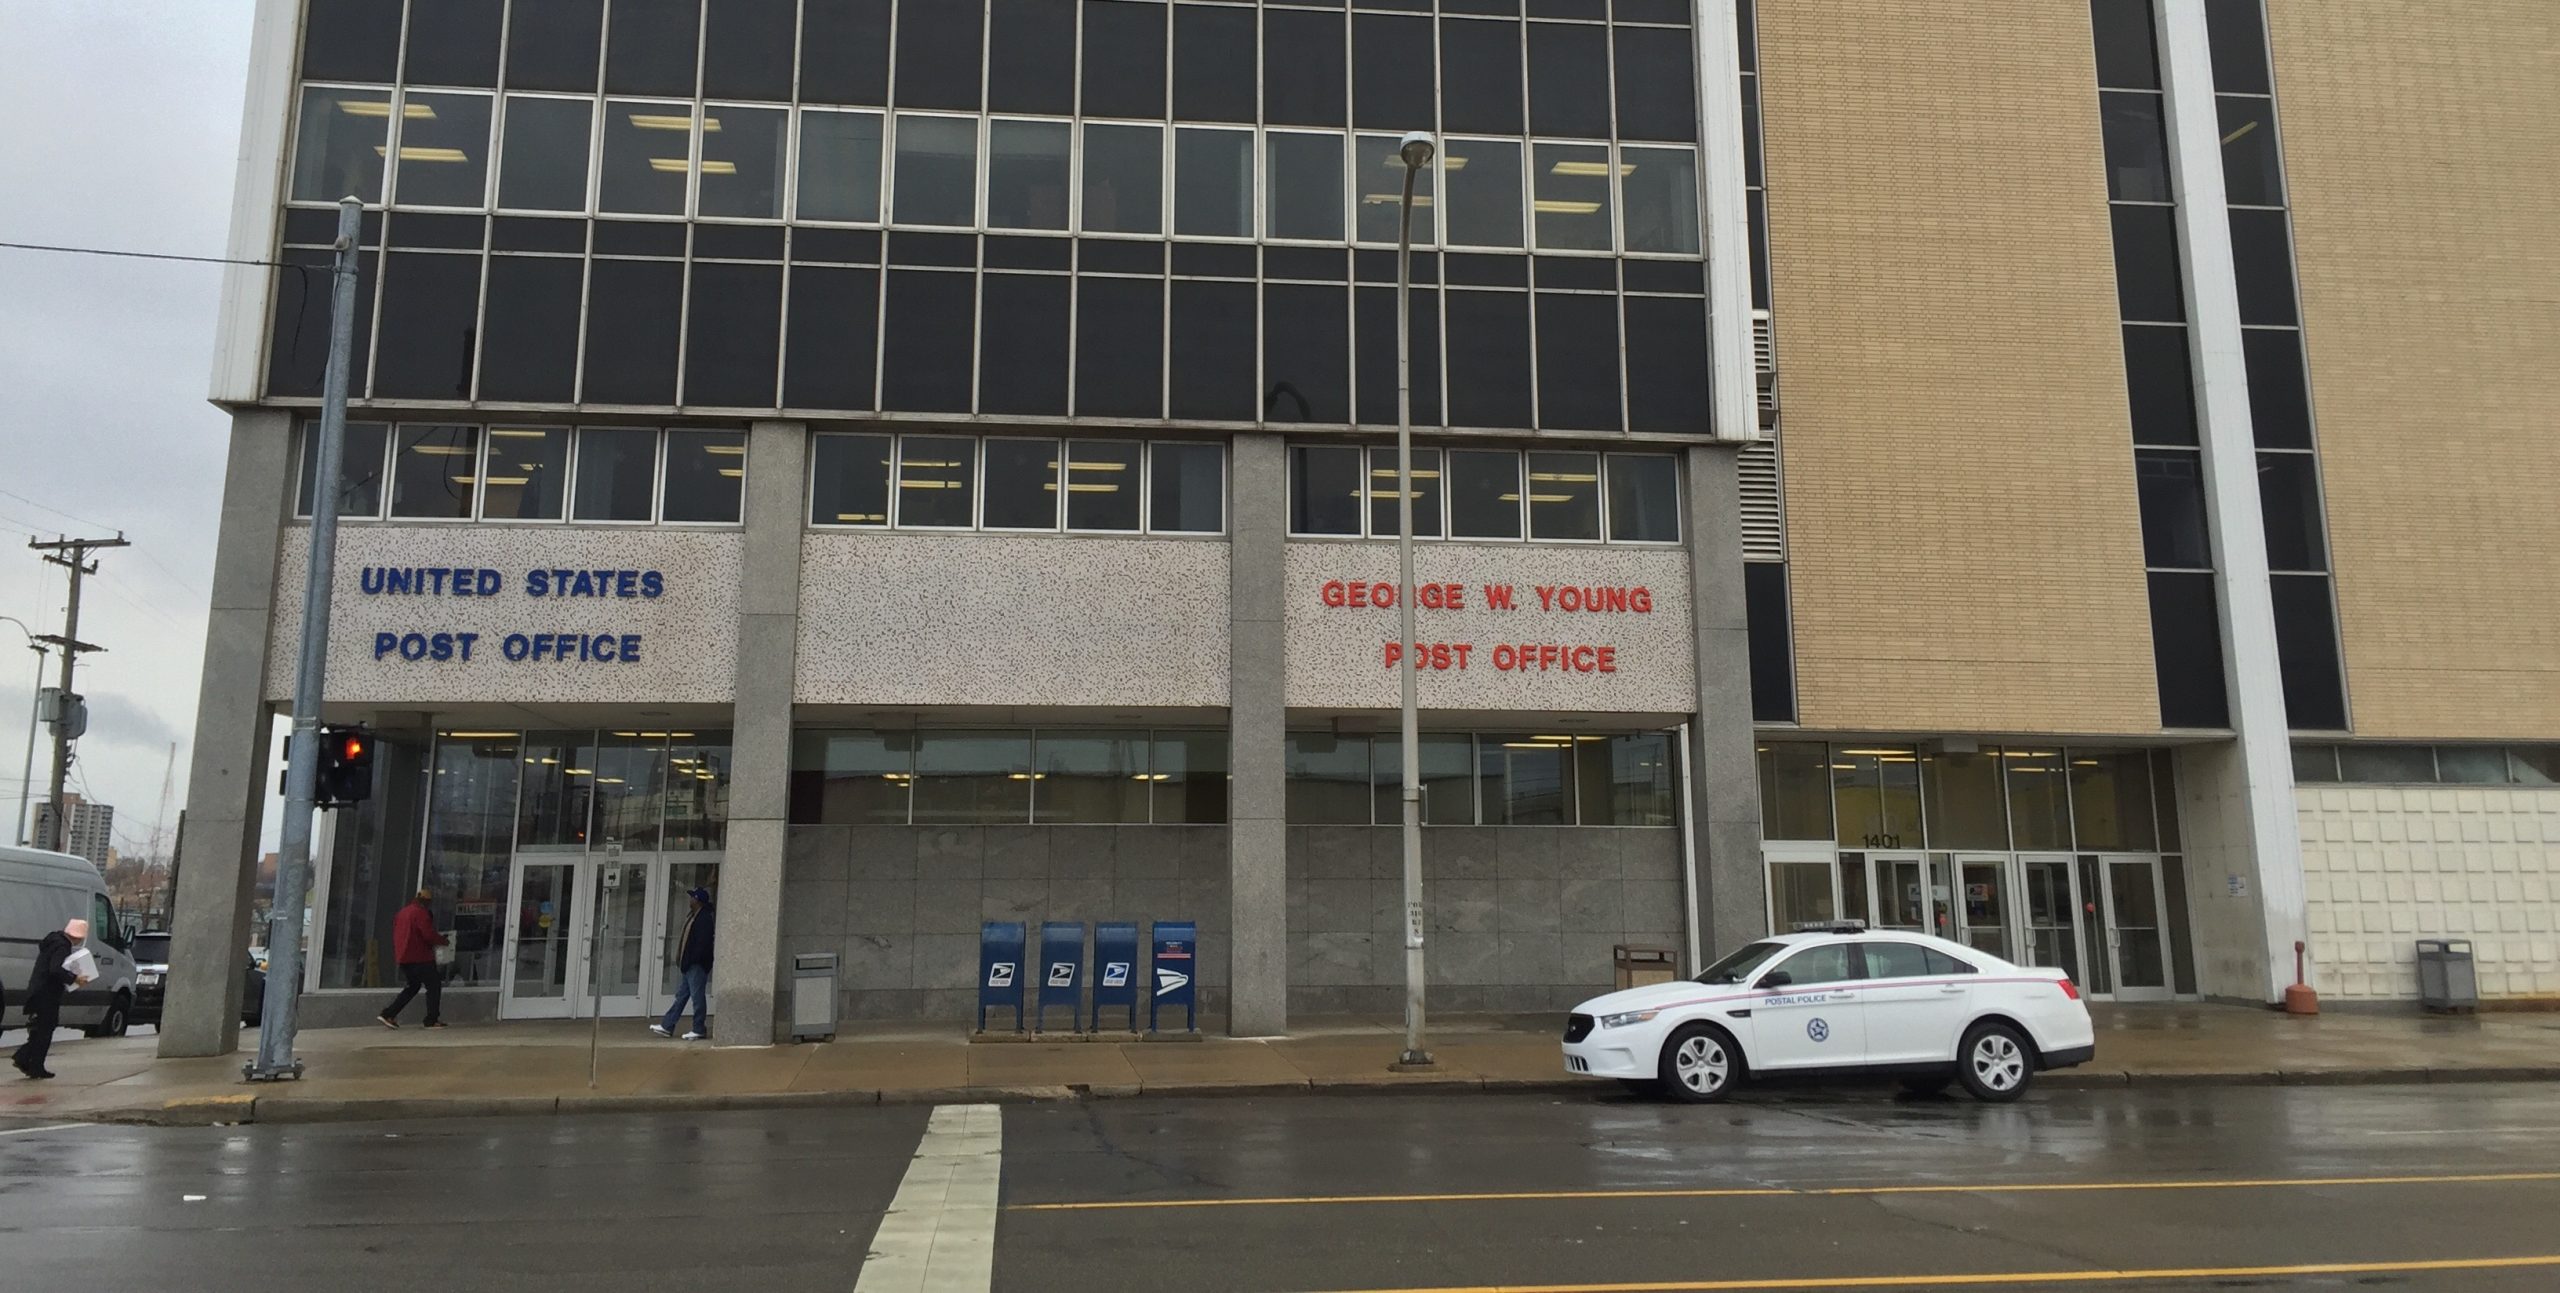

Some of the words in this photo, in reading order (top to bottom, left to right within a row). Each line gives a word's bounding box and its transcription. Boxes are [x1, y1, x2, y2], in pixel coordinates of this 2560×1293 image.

[361, 567, 501, 596] UNITED
[527, 569, 664, 597] STATES
[1484, 583, 1517, 610] W.
[1536, 584, 1653, 613] YOUNG
[374, 632, 478, 661] POST
[502, 633, 642, 662] OFFICE
[1491, 643, 1617, 673] OFFICE
[1862, 833, 1901, 849] 1401
[1764, 996, 1796, 1006] POSTAL
[1798, 994, 1827, 1003] POLICE
